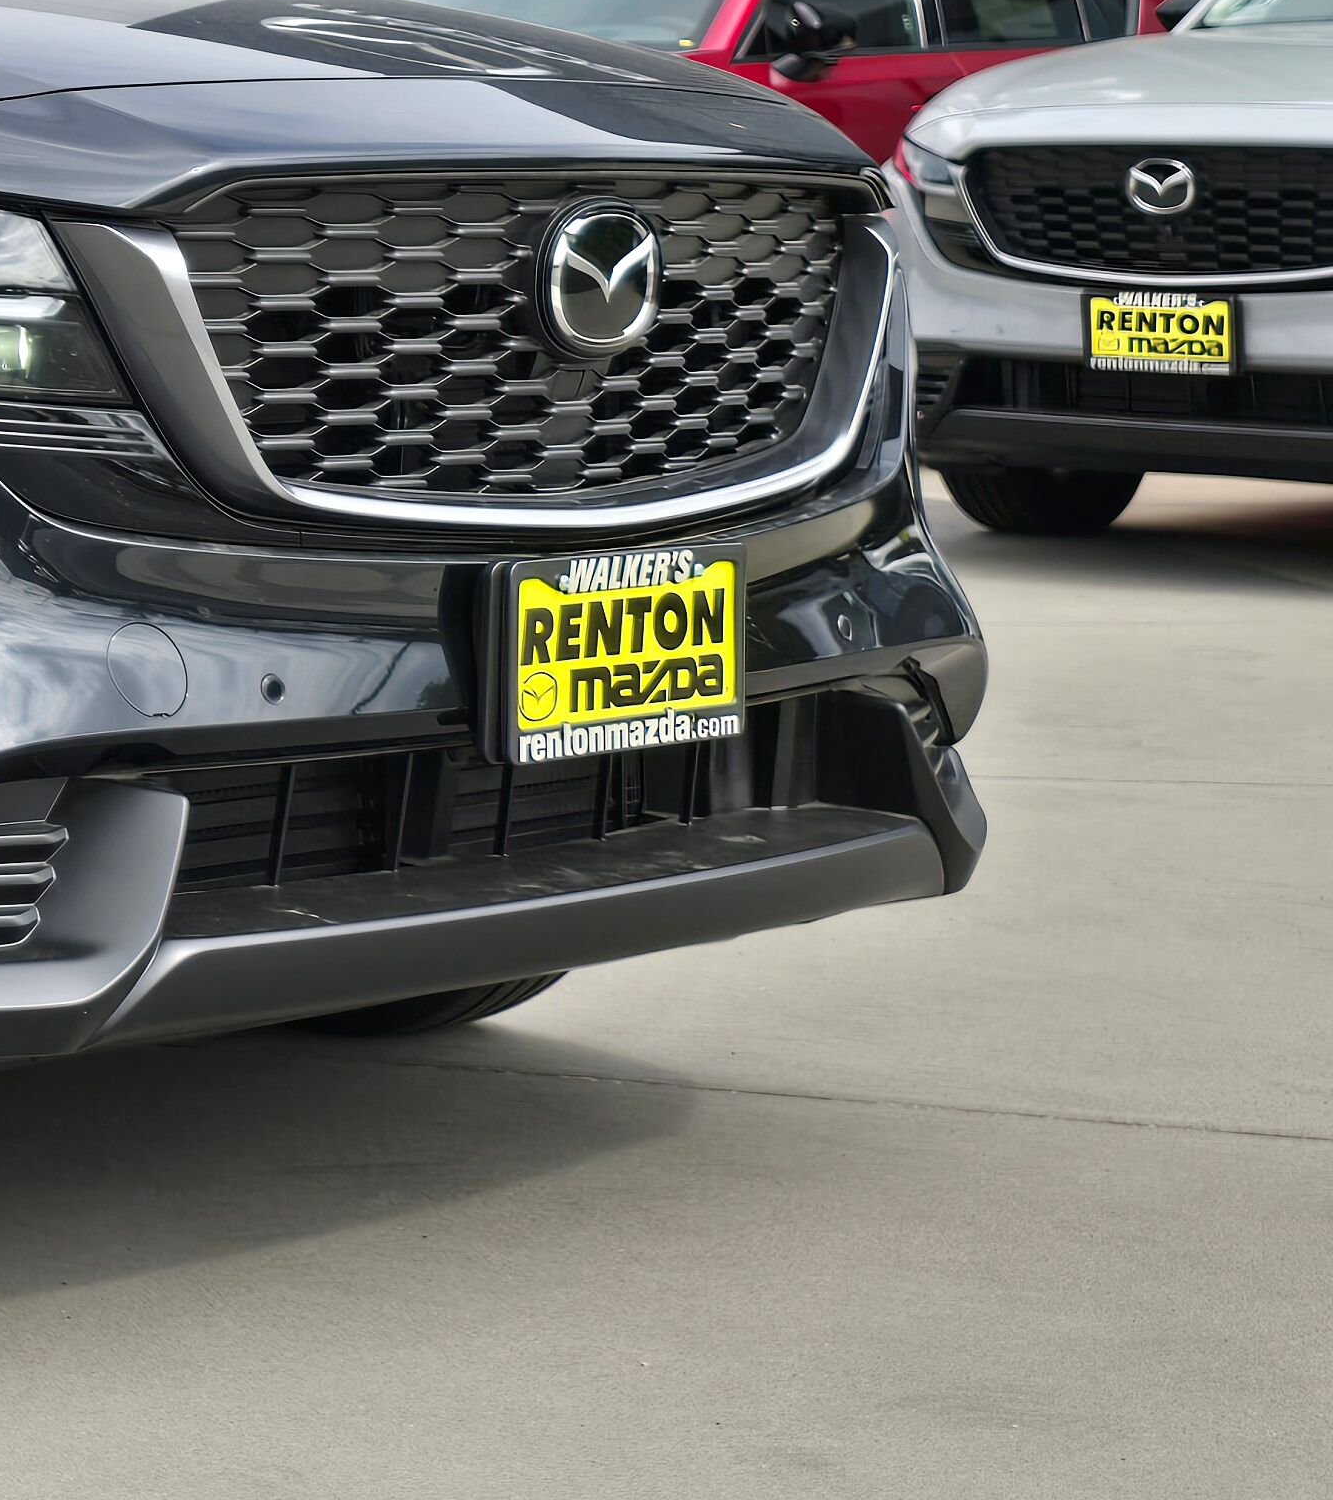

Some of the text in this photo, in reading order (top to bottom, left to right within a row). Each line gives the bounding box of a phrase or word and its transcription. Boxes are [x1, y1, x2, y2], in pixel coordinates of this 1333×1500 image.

[1098, 310, 1225, 336] RENTON
[568, 549, 693, 595] WALKER'S
[520, 588, 725, 666] RENTON
[518, 706, 740, 763] rentonmazda.com
